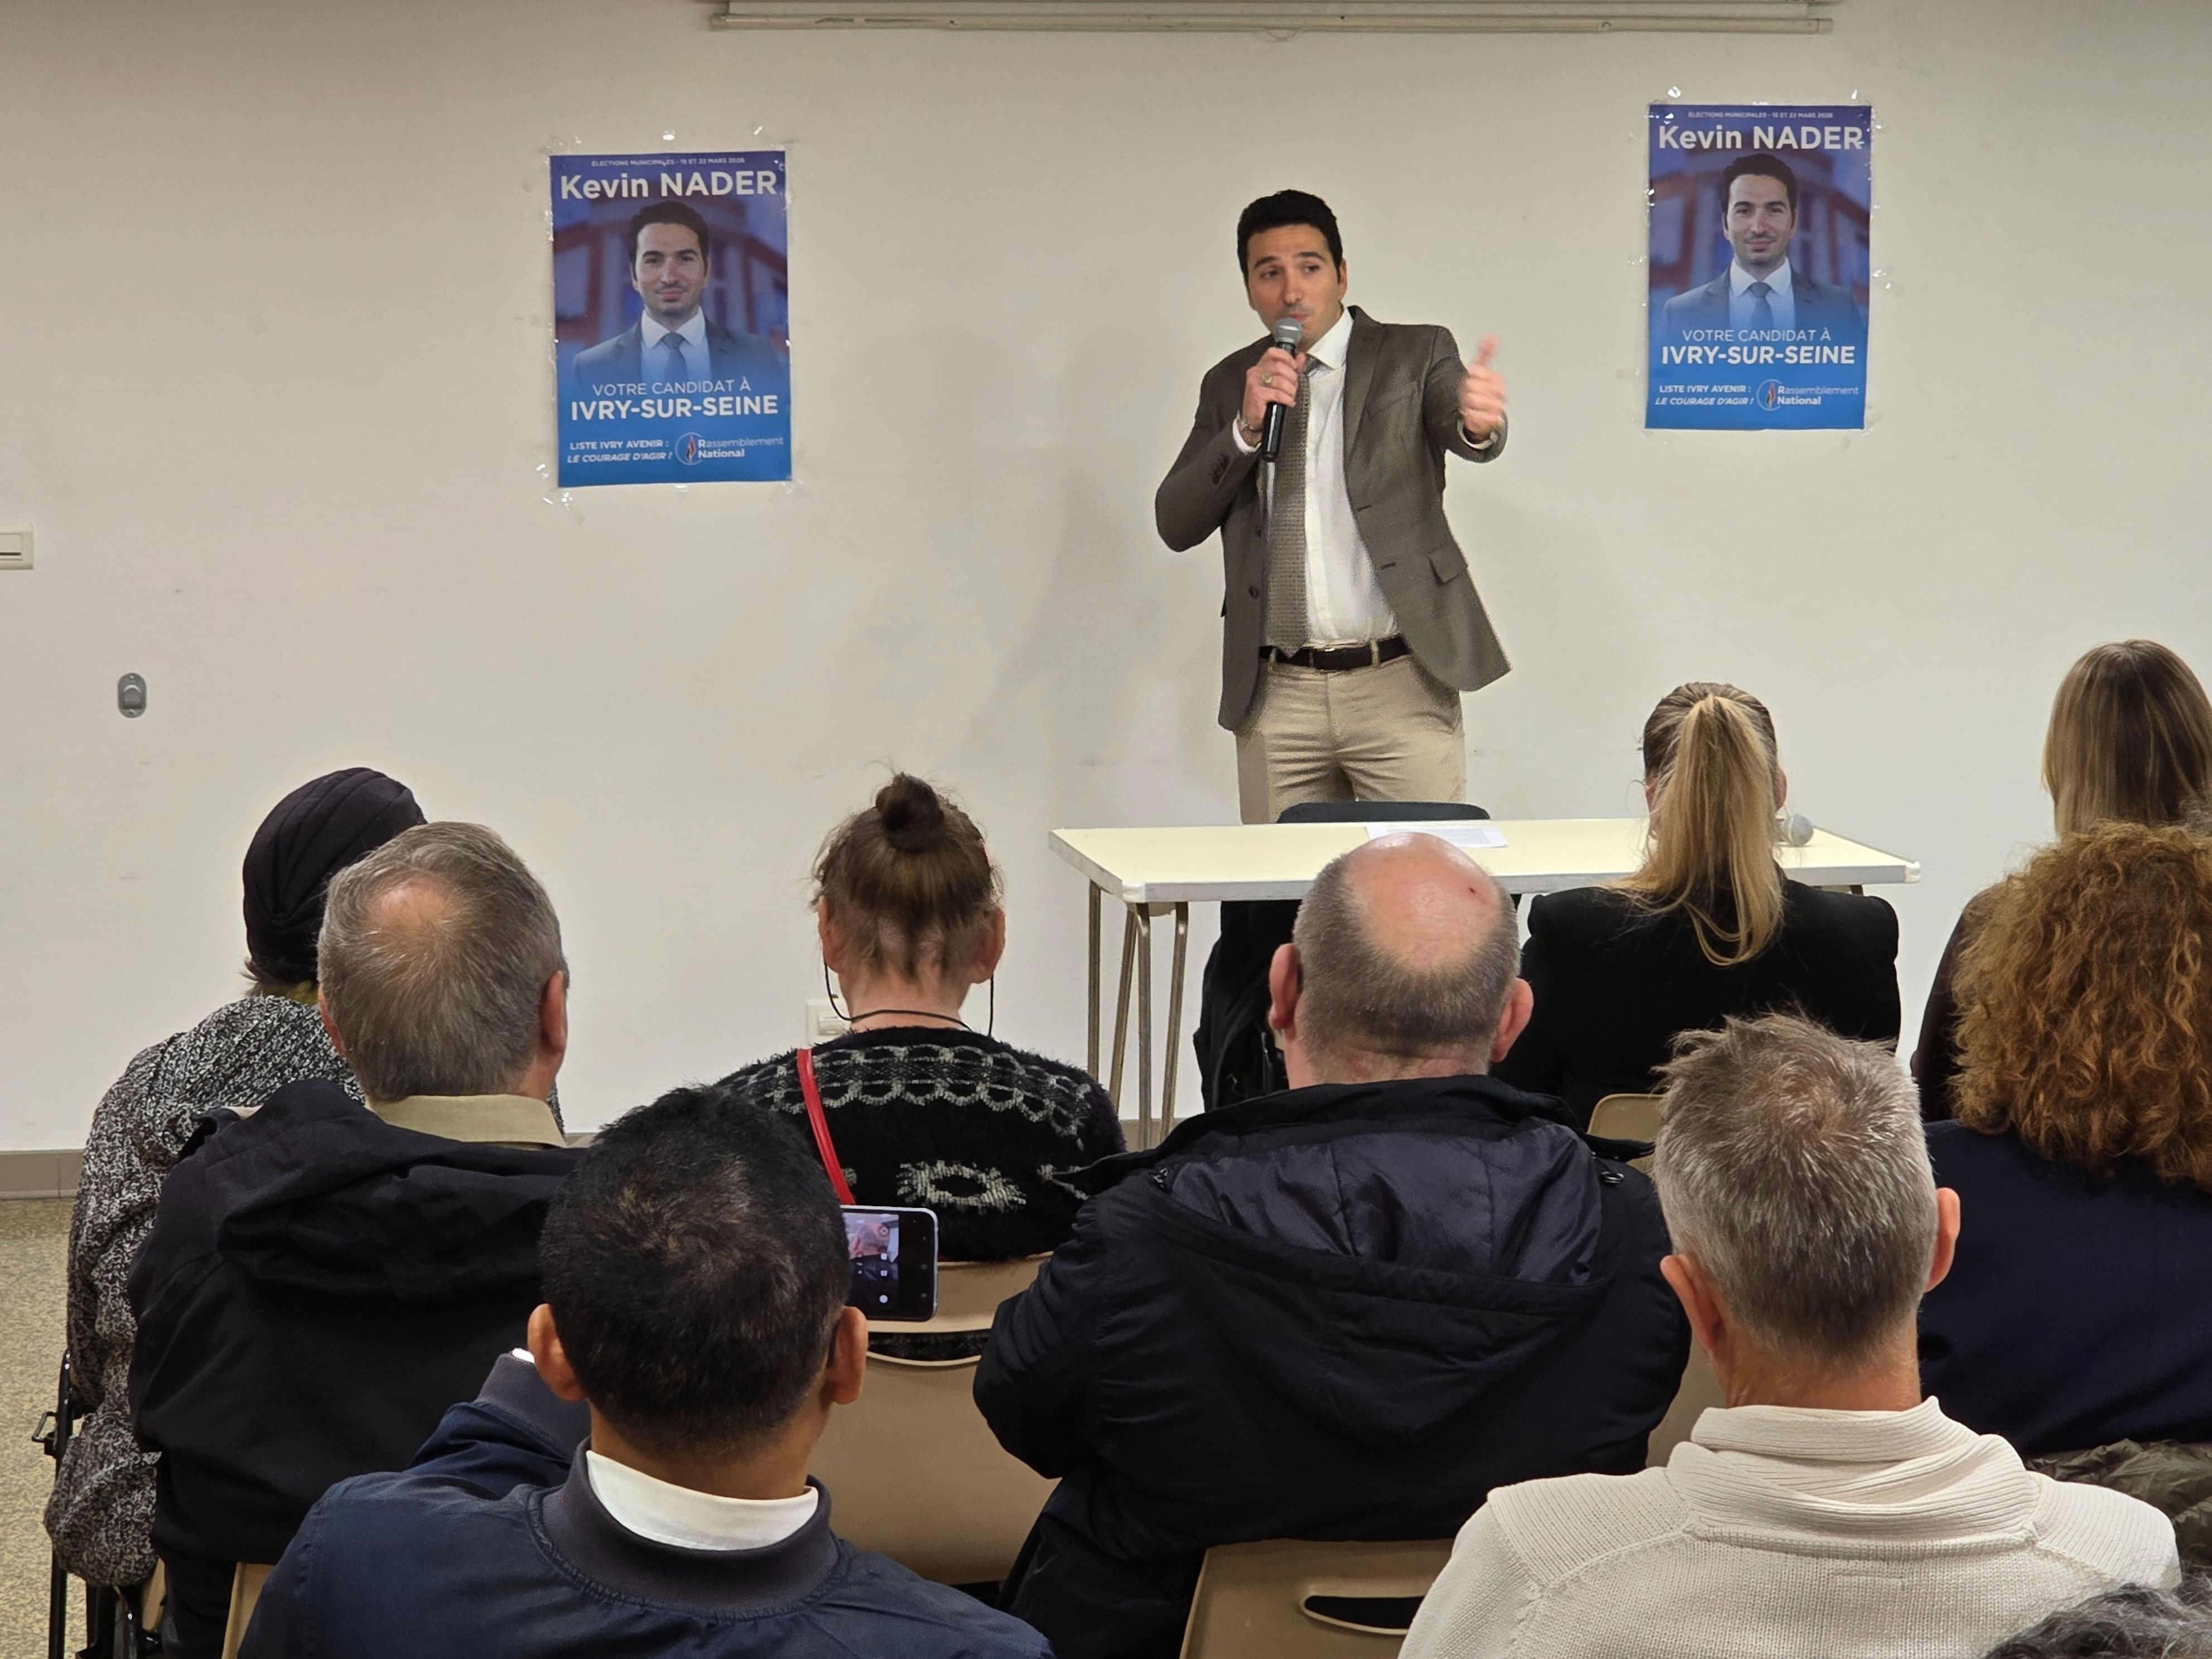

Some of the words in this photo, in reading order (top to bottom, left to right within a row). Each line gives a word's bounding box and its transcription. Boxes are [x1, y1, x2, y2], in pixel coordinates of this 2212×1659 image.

[1659, 125, 1742, 149] Kevin
[1753, 126, 1863, 150] NADER
[561, 173, 649, 200] Kevin
[661, 171, 777, 197] NADER
[1682, 330, 1734, 342] VOTRE
[1738, 330, 1817, 342] CANDIDAT
[1820, 327, 1832, 341] À
[1662, 345, 1856, 364] IVRY-SUR-SEINE
[592, 382, 648, 397] VOTRE
[652, 379, 735, 395] CANDIDAT
[739, 376, 751, 392] À
[1777, 385, 1859, 394] Rassemblement
[1777, 396, 1821, 405] National
[571, 394, 779, 421] IVRY-SUR-SEINE
[569, 441, 597, 450] LISTE
[600, 440, 624, 449] IVRY
[626, 439, 663, 448] AVENIR
[697, 437, 784, 448] Rassemblement
[567, 455, 580, 463] LE
[581, 453, 631, 462] COURAGE
[697, 448, 745, 458] National
